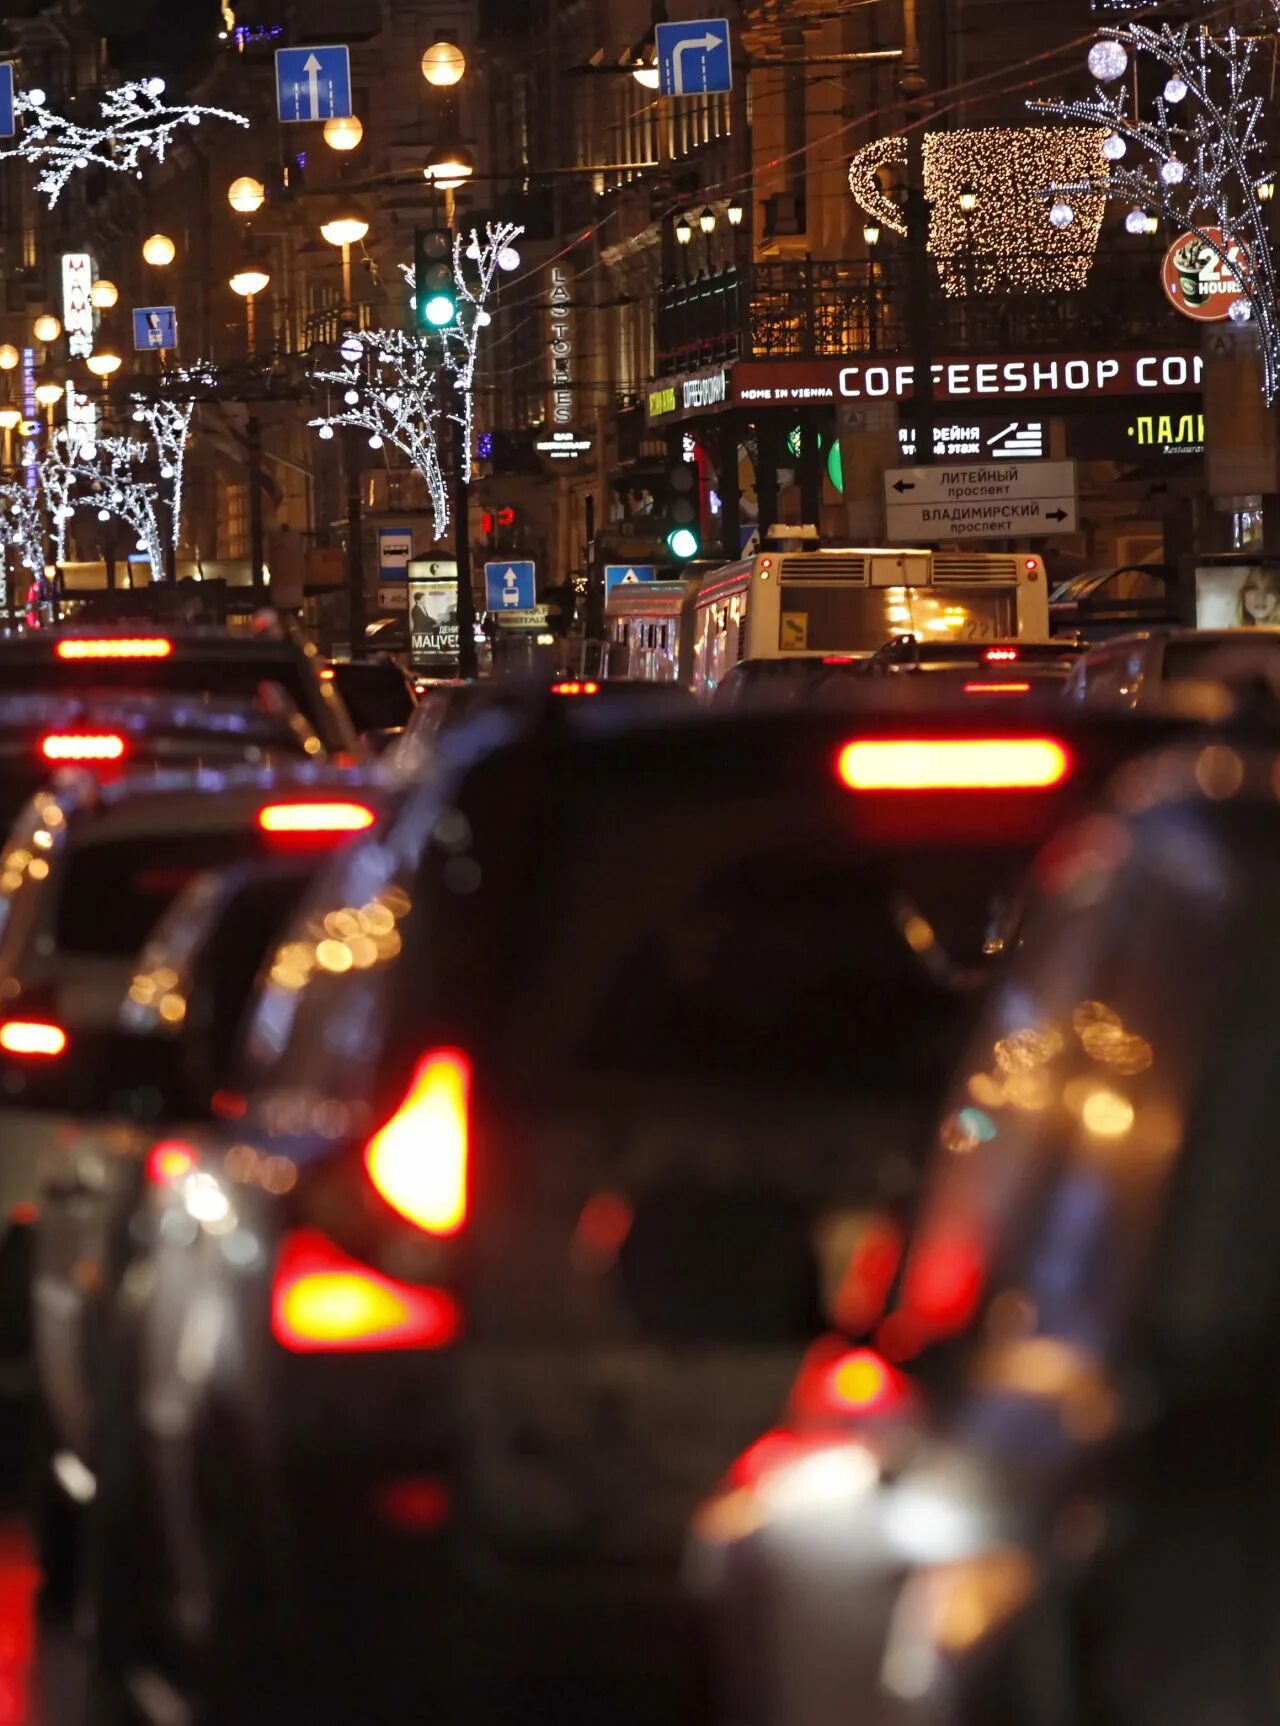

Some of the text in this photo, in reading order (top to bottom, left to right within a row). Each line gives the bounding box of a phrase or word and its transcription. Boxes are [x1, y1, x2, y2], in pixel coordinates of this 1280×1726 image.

[741, 388, 833, 399] HOME IN VIENNA
[941, 467, 1018, 485] ЛИТЕЙНЫЙ
[948, 486, 1011, 498] проспект
[922, 502, 1040, 521] ВЛАДИМИРСКИЙ
[950, 521, 1013, 533] проспект
